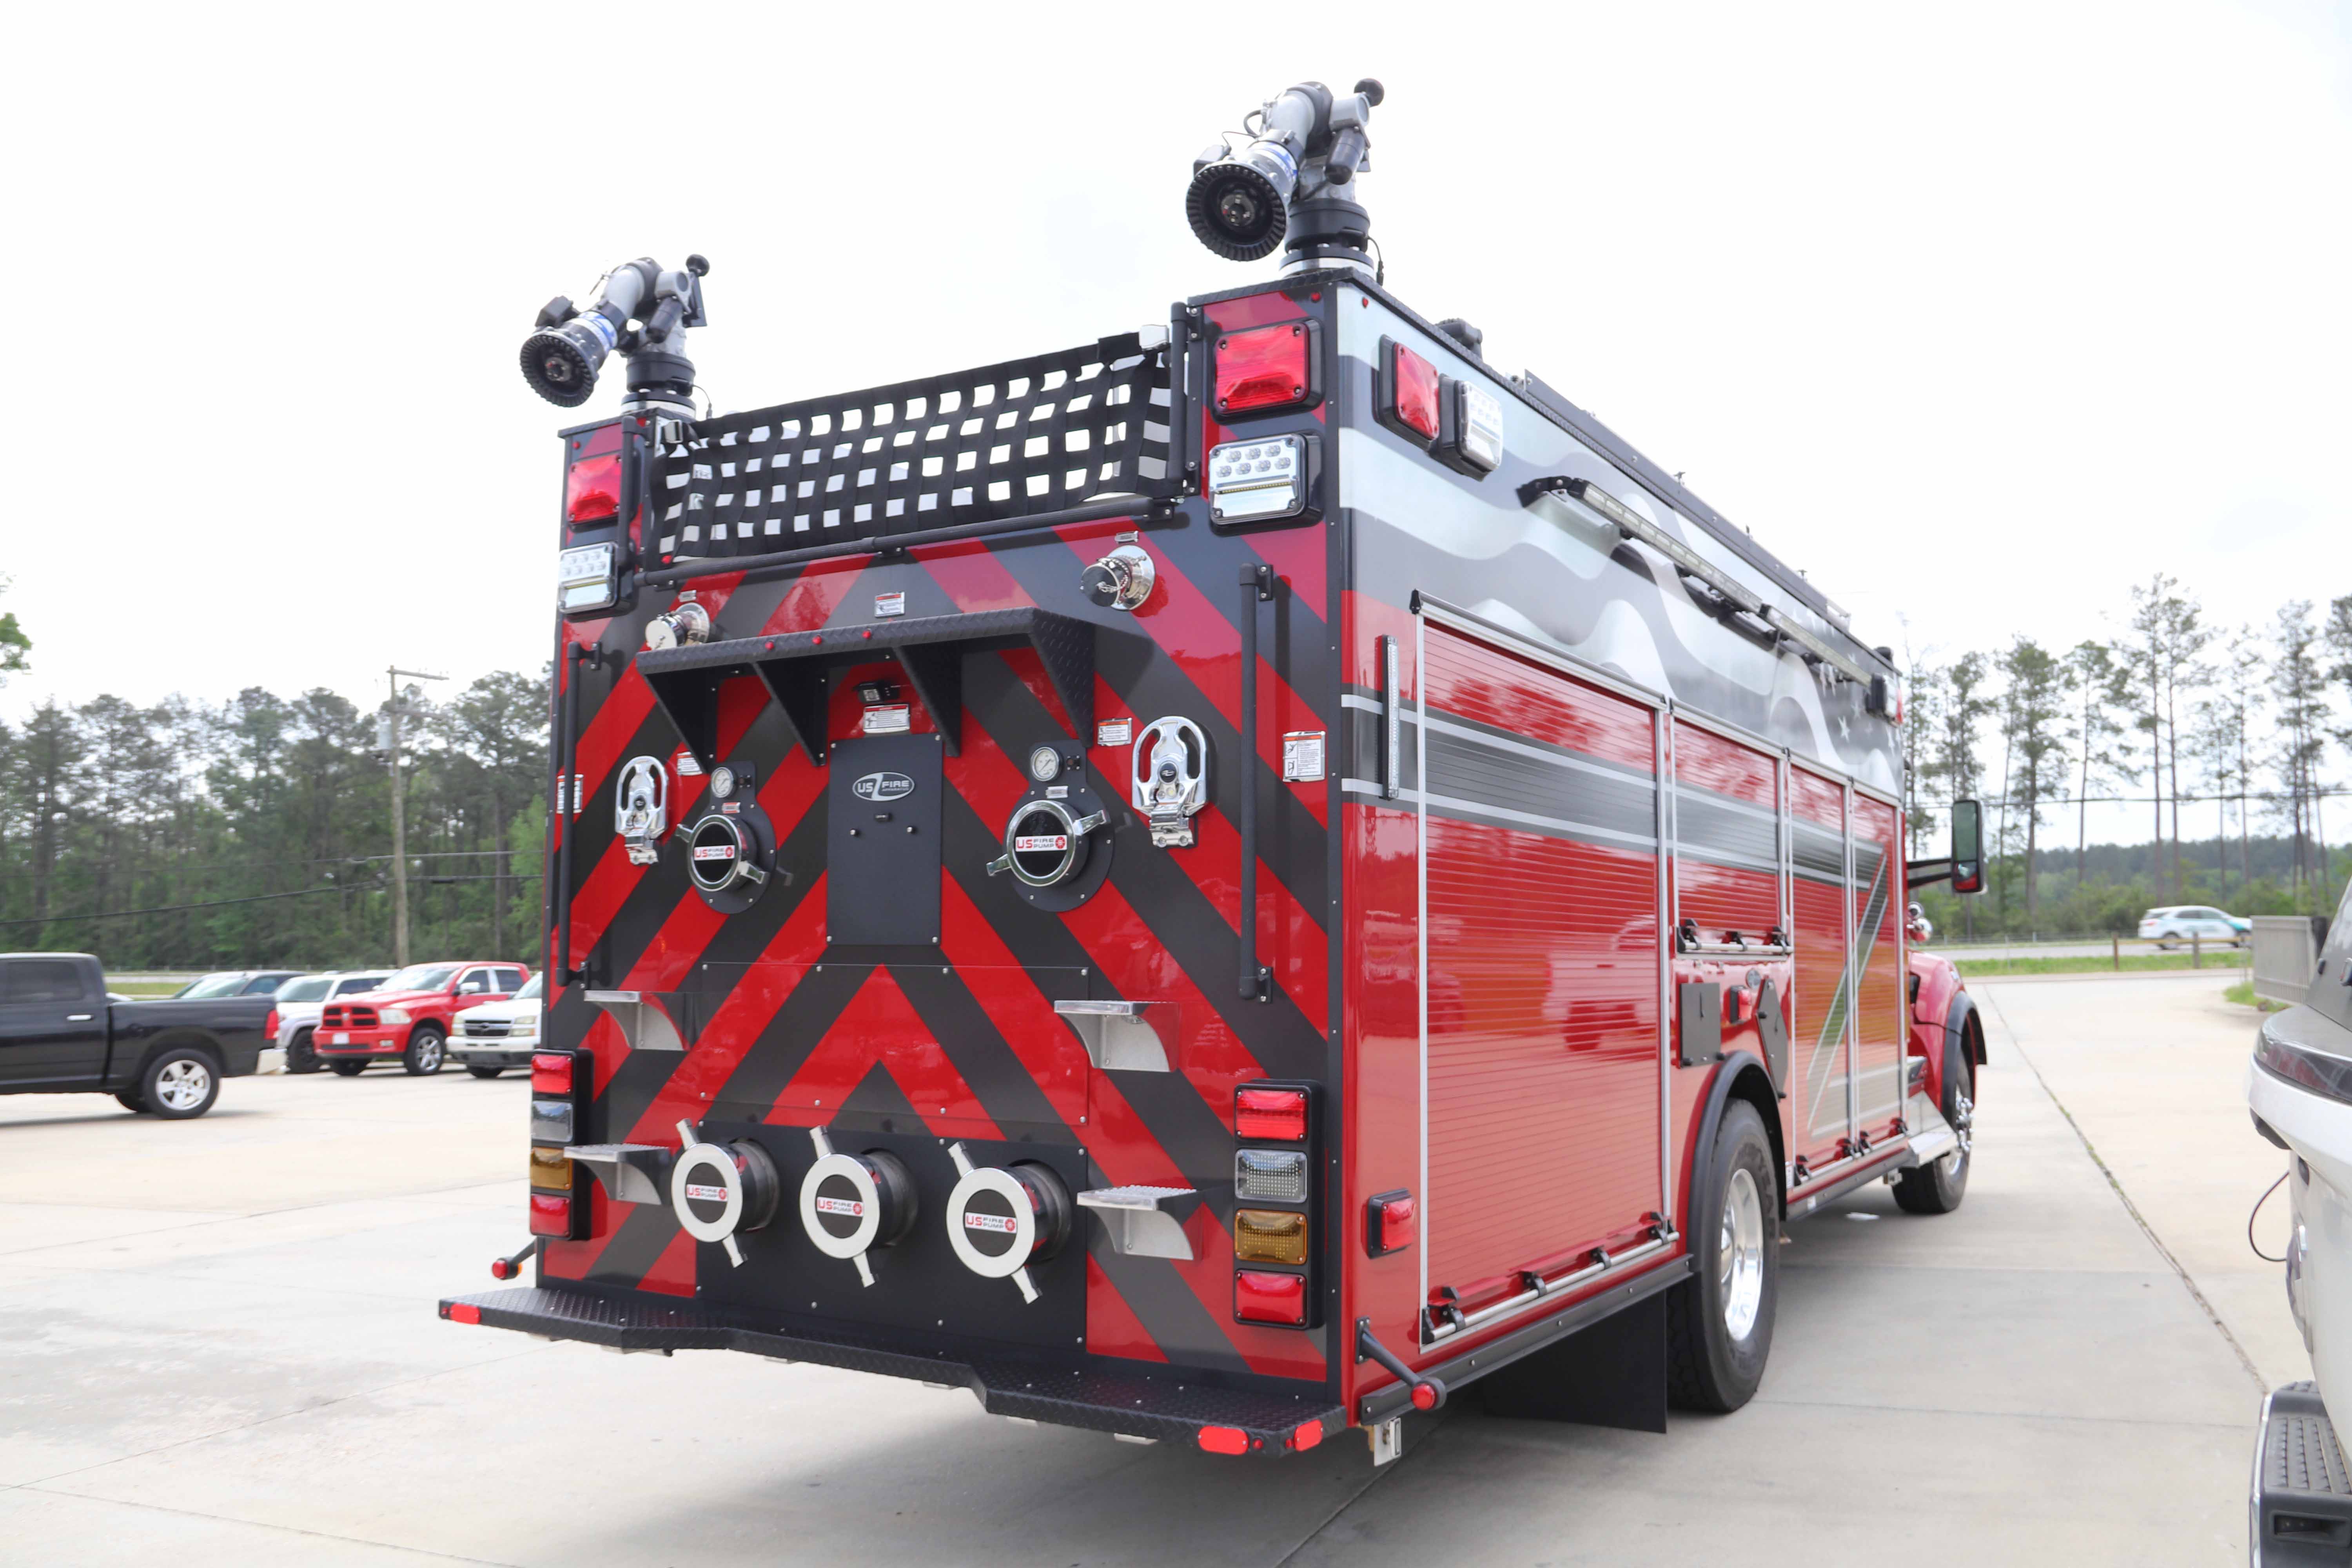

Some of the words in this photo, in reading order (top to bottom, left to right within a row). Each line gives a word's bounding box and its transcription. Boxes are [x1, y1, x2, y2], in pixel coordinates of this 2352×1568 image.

[857, 782, 873, 793] US
[1017, 839, 1033, 849] US
[694, 849, 708, 858] US
[688, 1187, 701, 1196] US
[818, 1200, 833, 1209] US
[967, 1215, 982, 1226] US
